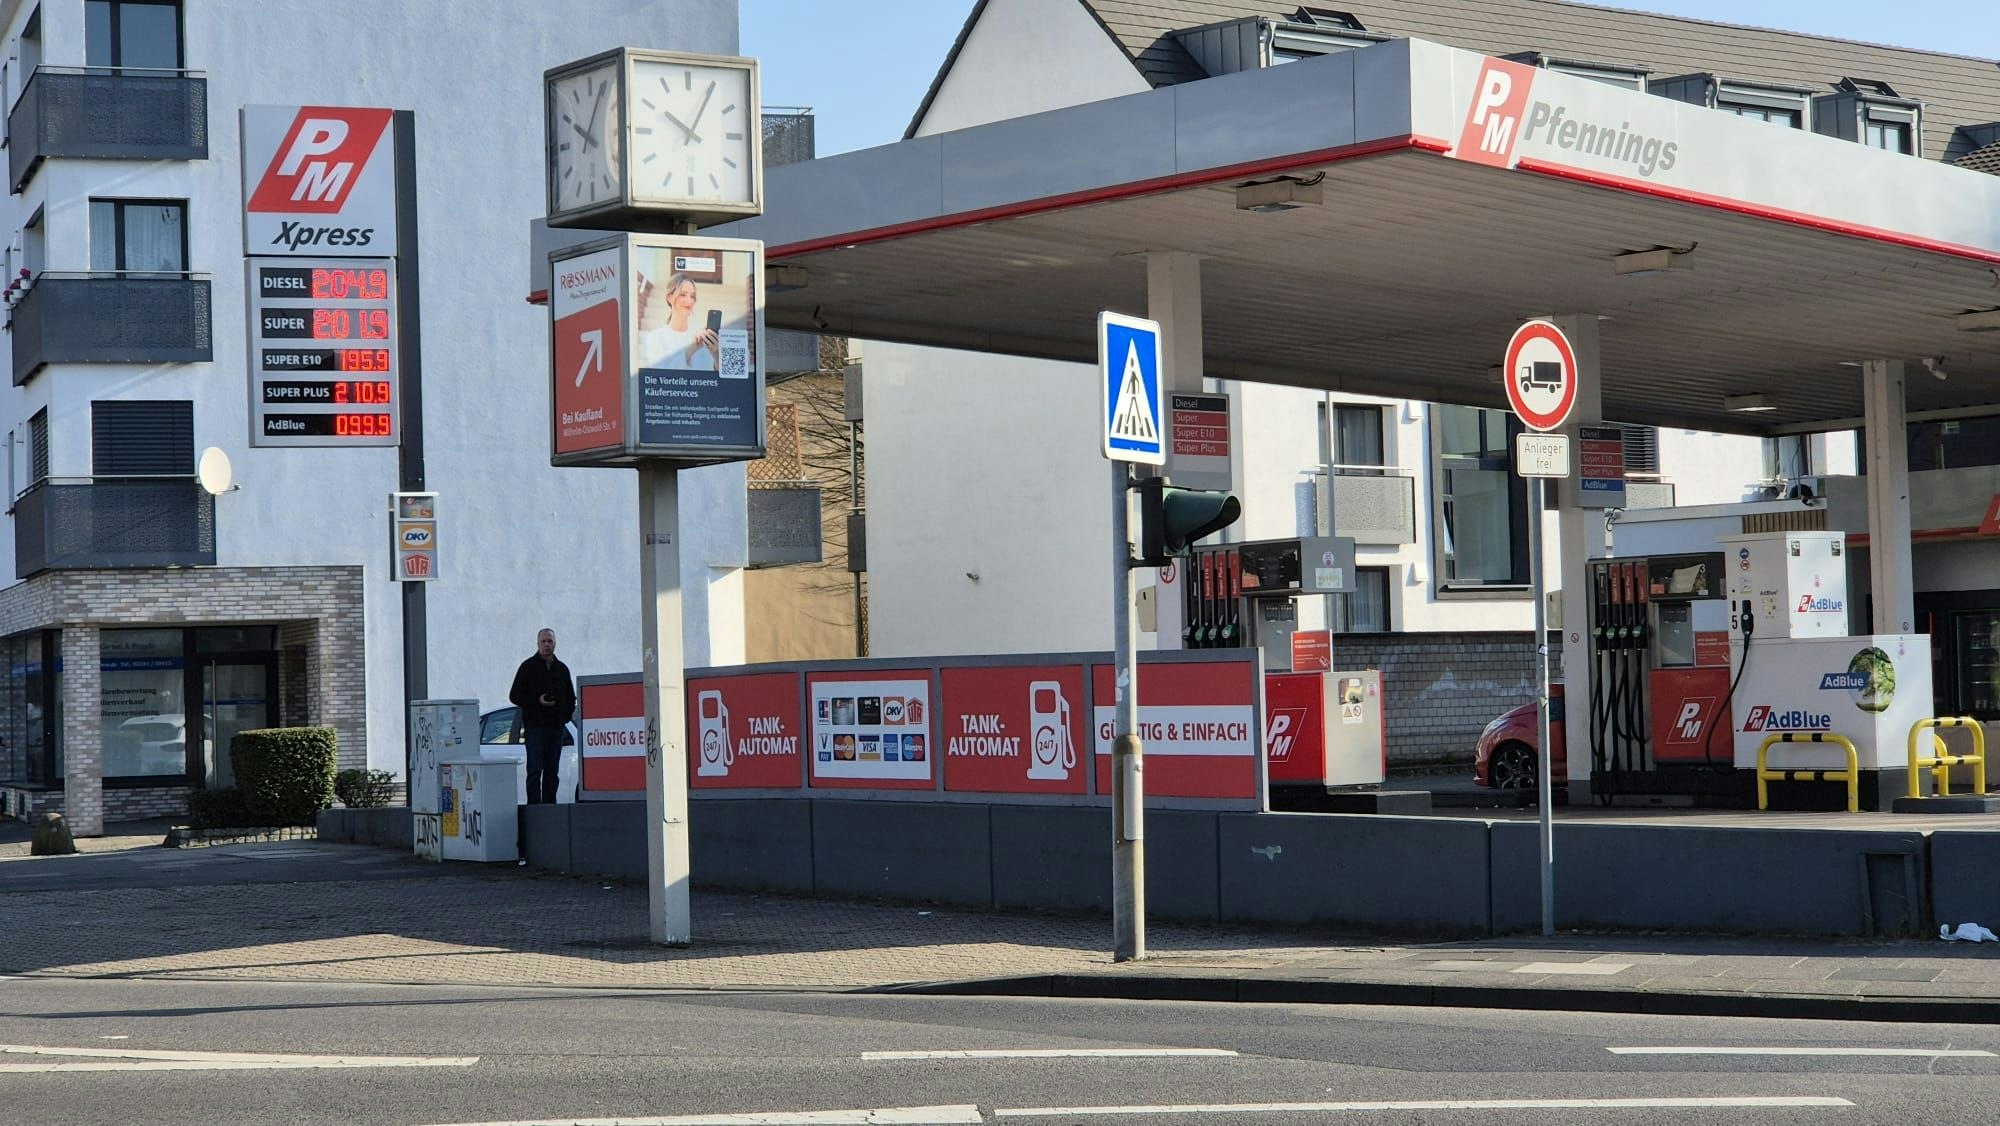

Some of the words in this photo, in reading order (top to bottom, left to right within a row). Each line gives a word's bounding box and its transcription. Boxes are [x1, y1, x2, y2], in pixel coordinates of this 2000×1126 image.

[1524, 101, 1678, 177] Pfennings
[272, 221, 374, 251] Xpress
[561, 264, 615, 290] ROSSMANN
[263, 277, 306, 289] DIESEL
[265, 317, 305, 330] SUPER
[265, 354, 300, 365] SUPER
[302, 354, 322, 365] E10
[644, 376, 657, 384] Die
[659, 377, 687, 386] Vorteile
[689, 378, 718, 387] unseres
[266, 387, 301, 398] SUPER
[303, 387, 330, 398] PLUS
[645, 388, 699, 398] Käuferservices
[1175, 398, 1198, 408] Diesel
[562, 412, 573, 424] Bei
[1176, 413, 1198, 424] Super
[267, 420, 306, 430] AdBlue
[1176, 429, 1200, 439] Super
[1201, 429, 1215, 438] E10
[1177, 442, 1198, 453] Super
[1201, 444, 1216, 453] Plus
[1524, 442, 1563, 456] Anlieger
[1536, 458, 1552, 469] frei
[405, 533, 429, 541] DKV
[1810, 599, 1842, 610] AdBlue
[1824, 675, 1864, 688] AdBlue
[886, 706, 903, 716] DKV
[961, 714, 1005, 734] TANK-
[1767, 711, 1830, 728] AdBlue
[748, 716, 785, 735] TANK-
[1167, 722, 1178, 741] &
[1183, 722, 1247, 741] EINFACH
[587, 730, 626, 746] GÜNSTIG
[629, 730, 636, 744] &
[705, 741, 718, 752] 24/7
[738, 736, 797, 756] AUTOMAT
[863, 743, 877, 752] VISA
[948, 736, 1020, 756] AUTOMAT
[1039, 740, 1054, 751] 24/7
